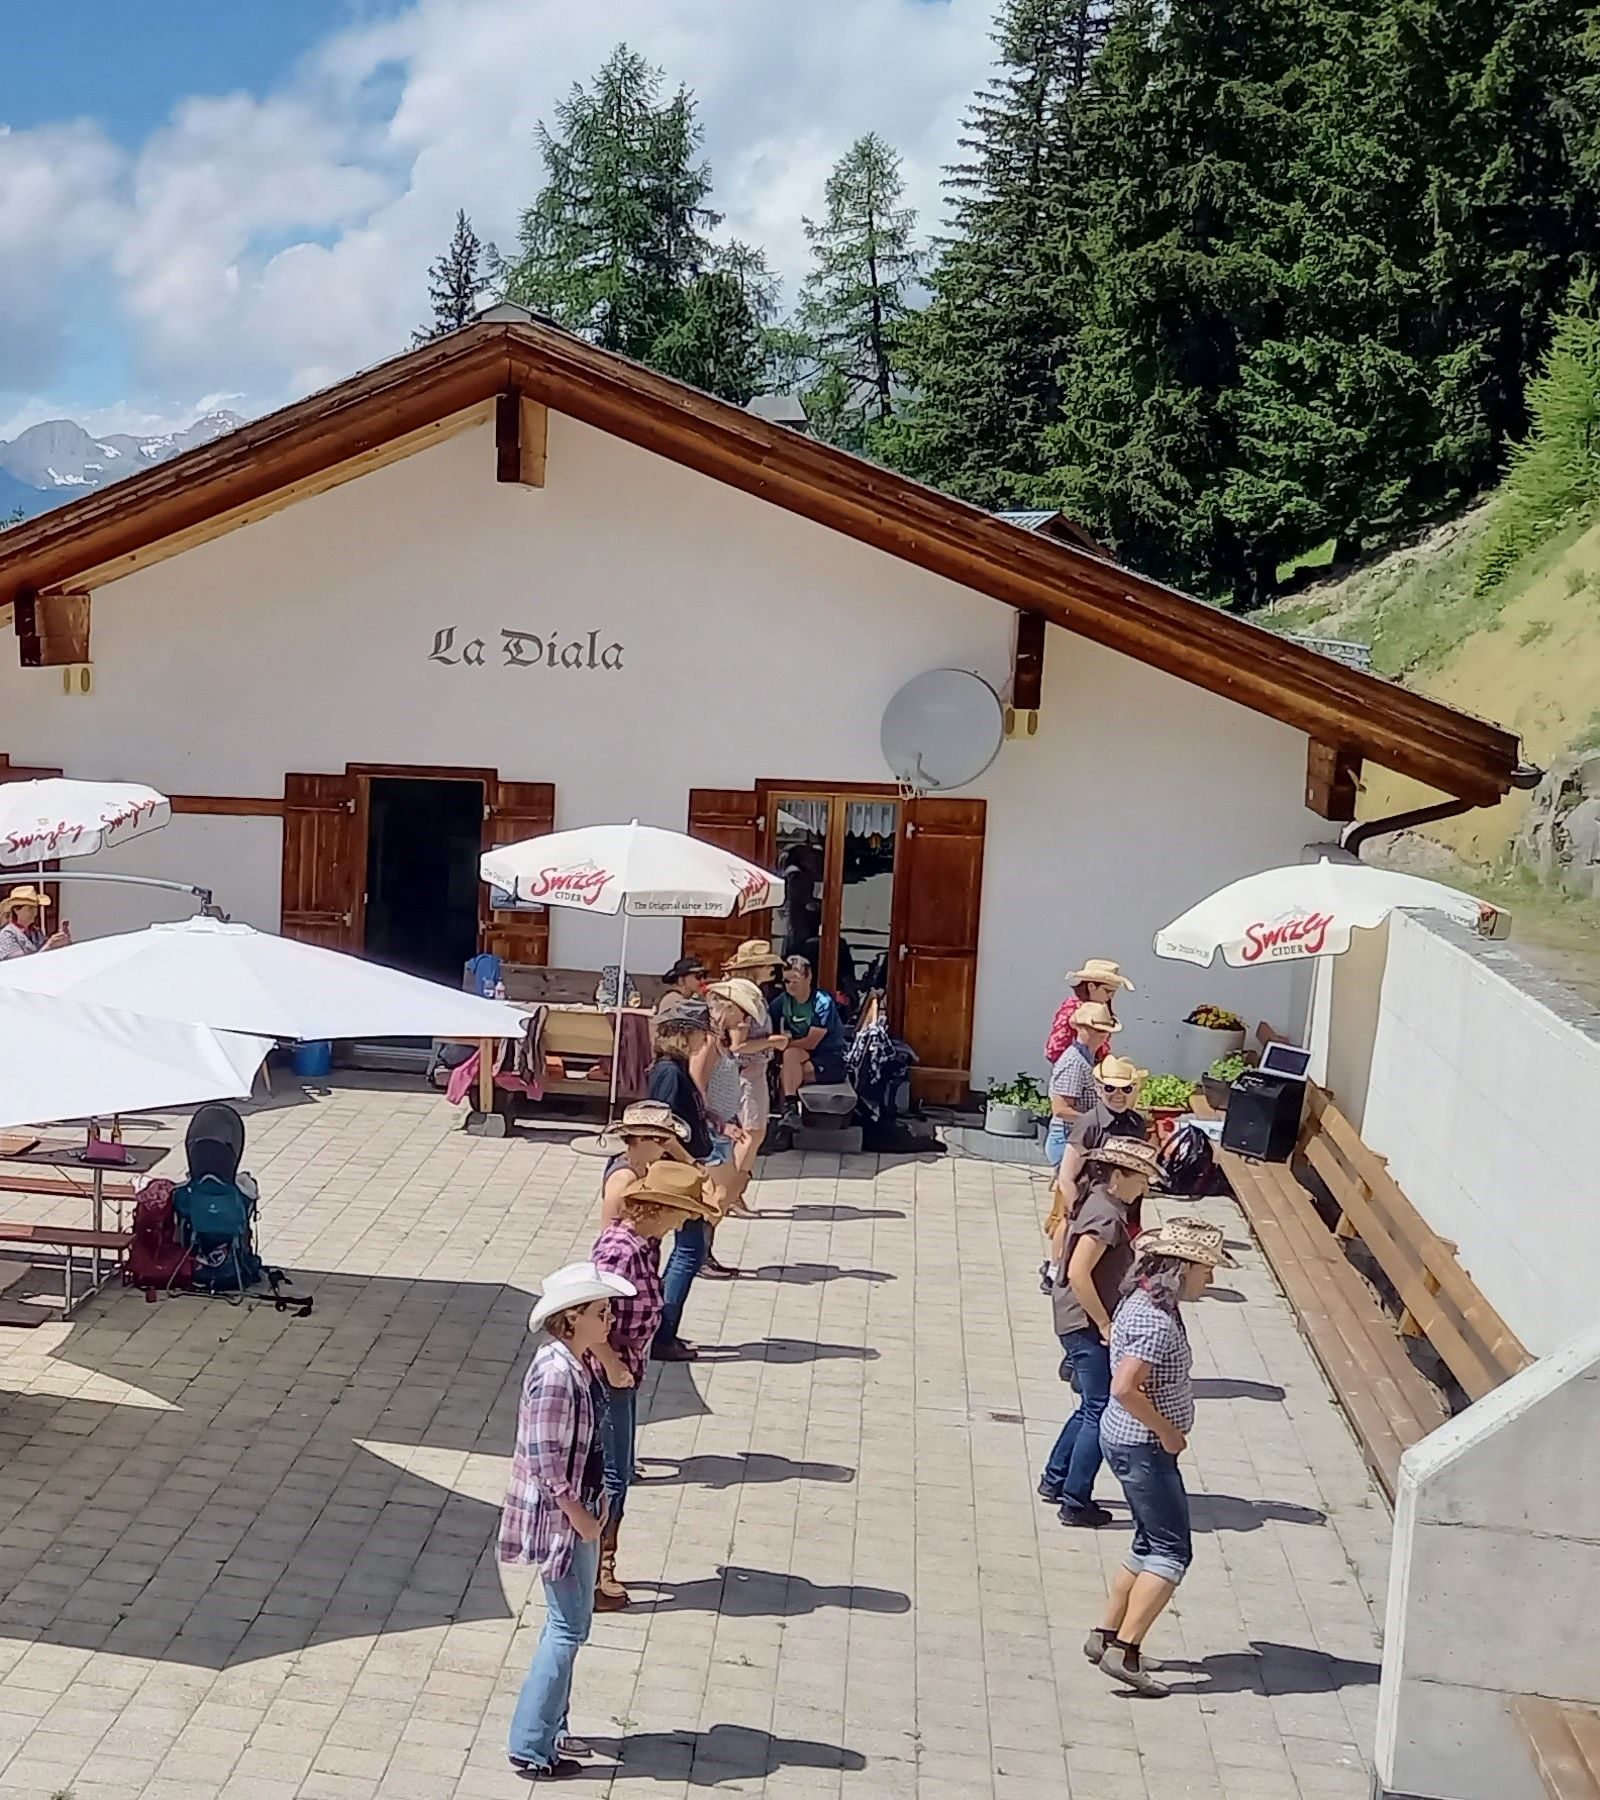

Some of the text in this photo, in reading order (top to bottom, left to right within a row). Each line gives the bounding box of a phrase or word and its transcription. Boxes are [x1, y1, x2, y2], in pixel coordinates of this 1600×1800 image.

[427, 626, 626, 670] La Diala
[530, 867, 616, 905] Swizly
[554, 891, 582, 902] CIDER
[1242, 913, 1335, 961] Swizly
[1271, 945, 1304, 957] CIDER
